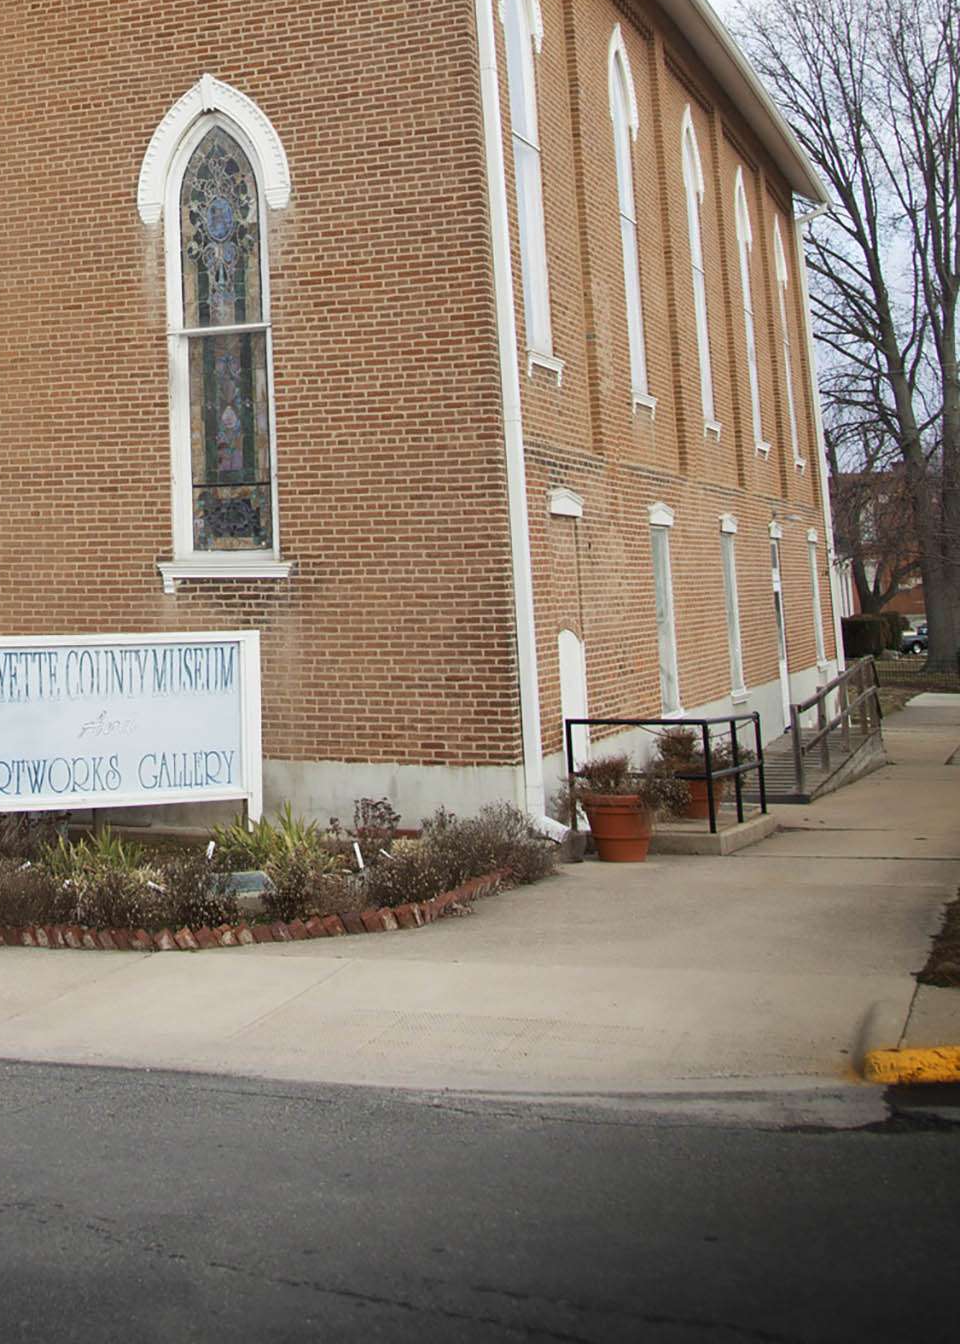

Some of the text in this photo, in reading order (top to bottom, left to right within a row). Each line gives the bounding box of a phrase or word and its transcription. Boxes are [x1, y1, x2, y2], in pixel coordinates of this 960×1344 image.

[65, 648, 148, 697] COUNTY
[151, 646, 235, 694] MUSEUM
[138, 750, 235, 790] GALLERY
